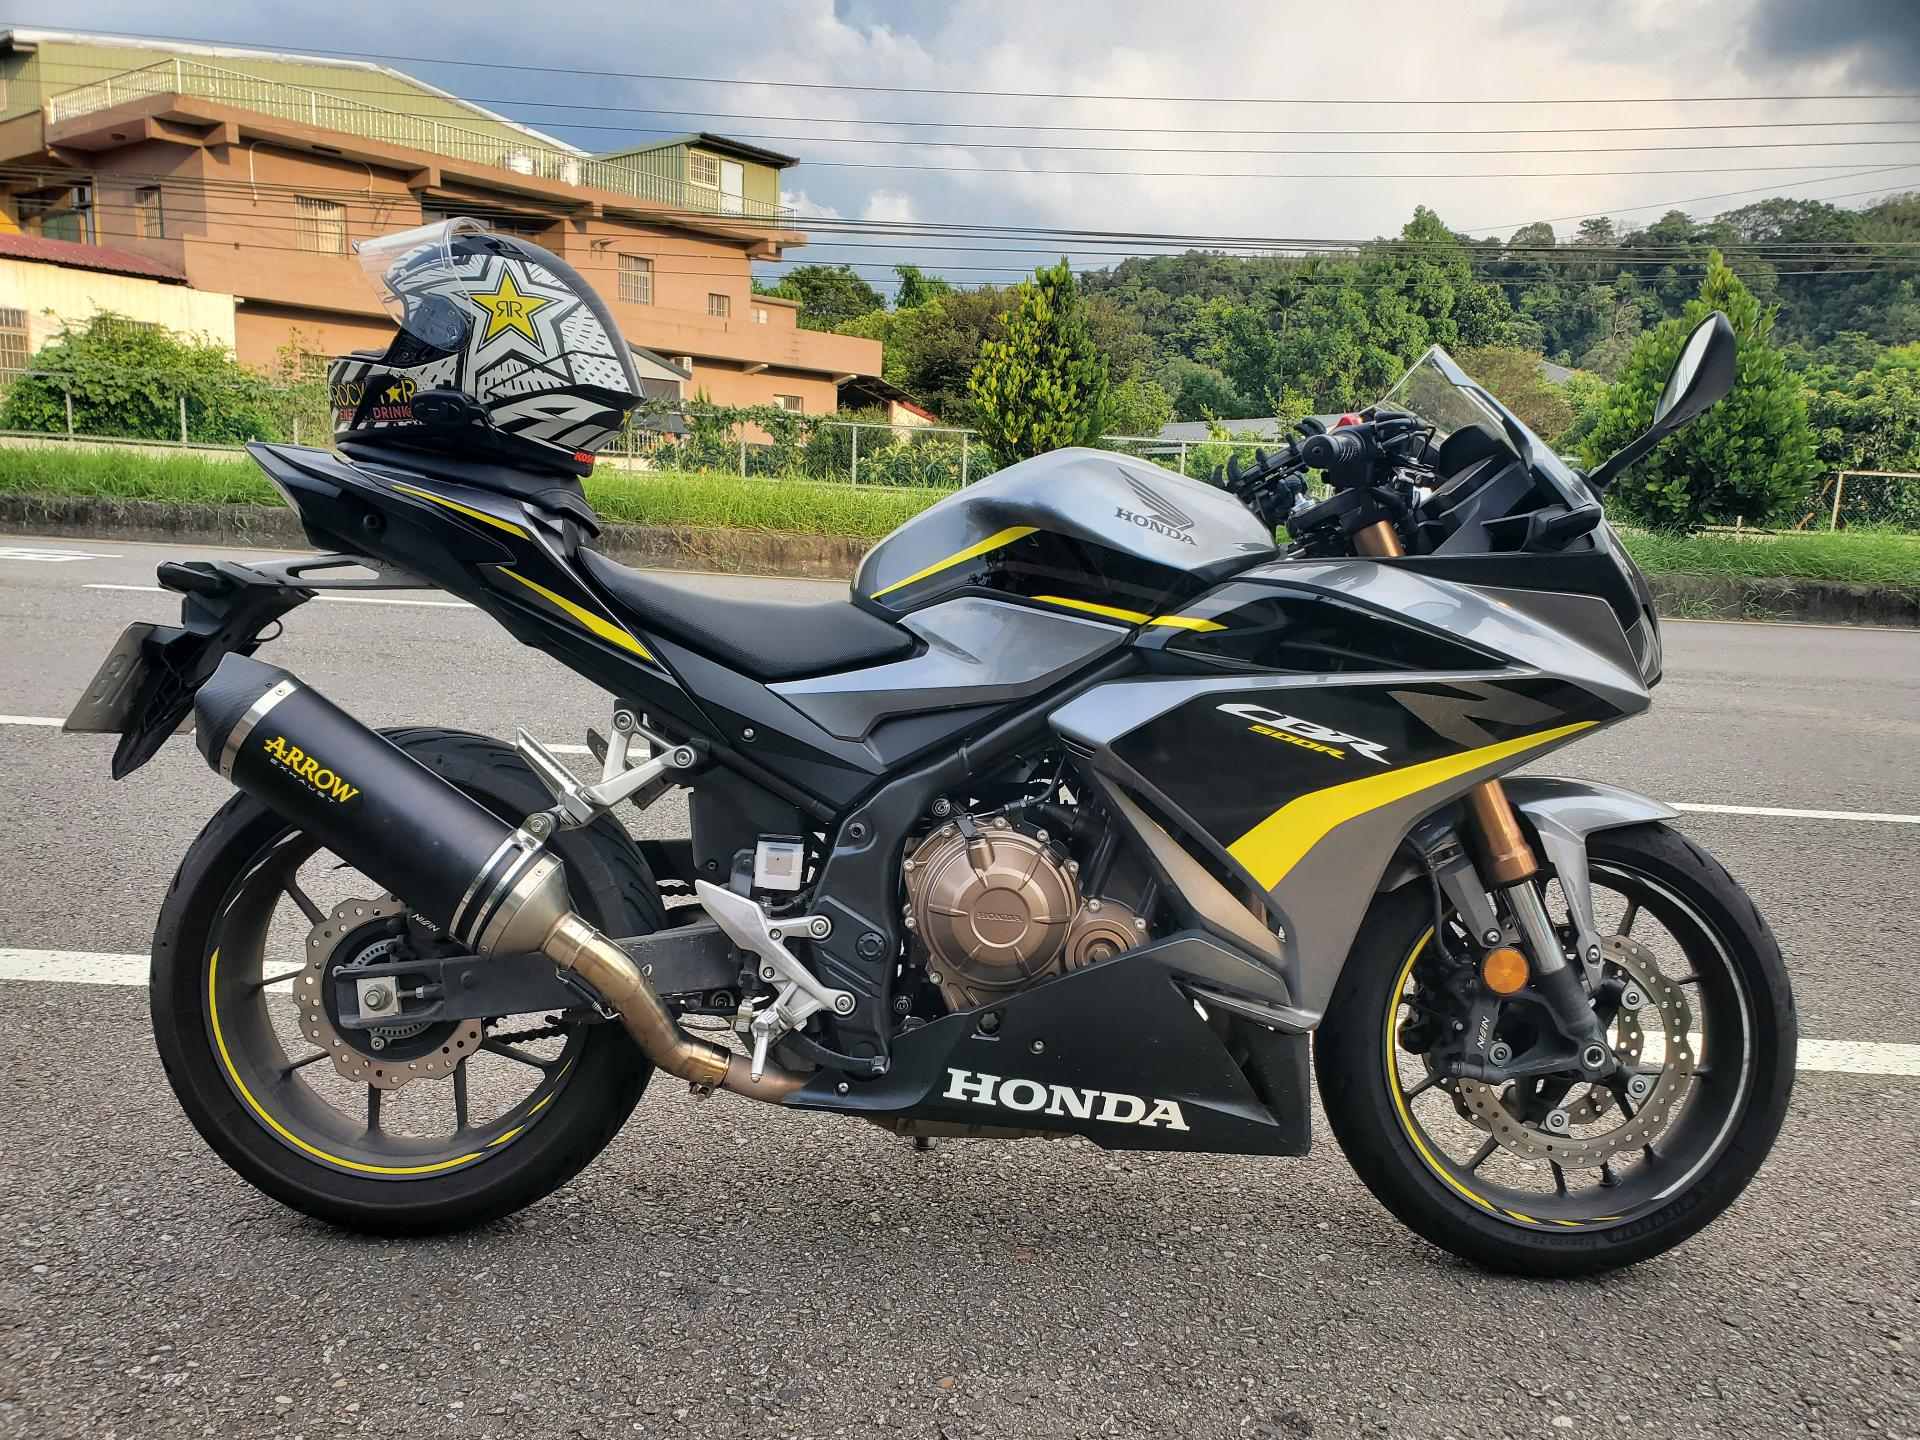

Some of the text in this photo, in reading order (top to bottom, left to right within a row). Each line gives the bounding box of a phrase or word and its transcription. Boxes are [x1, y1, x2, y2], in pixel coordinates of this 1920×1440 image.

[1114, 506, 1198, 546] HONDA
[1216, 703, 1392, 765] CBR
[1248, 724, 1345, 760] 500R
[263, 736, 360, 803] ARROW
[942, 1067, 1190, 1131] HONDA
